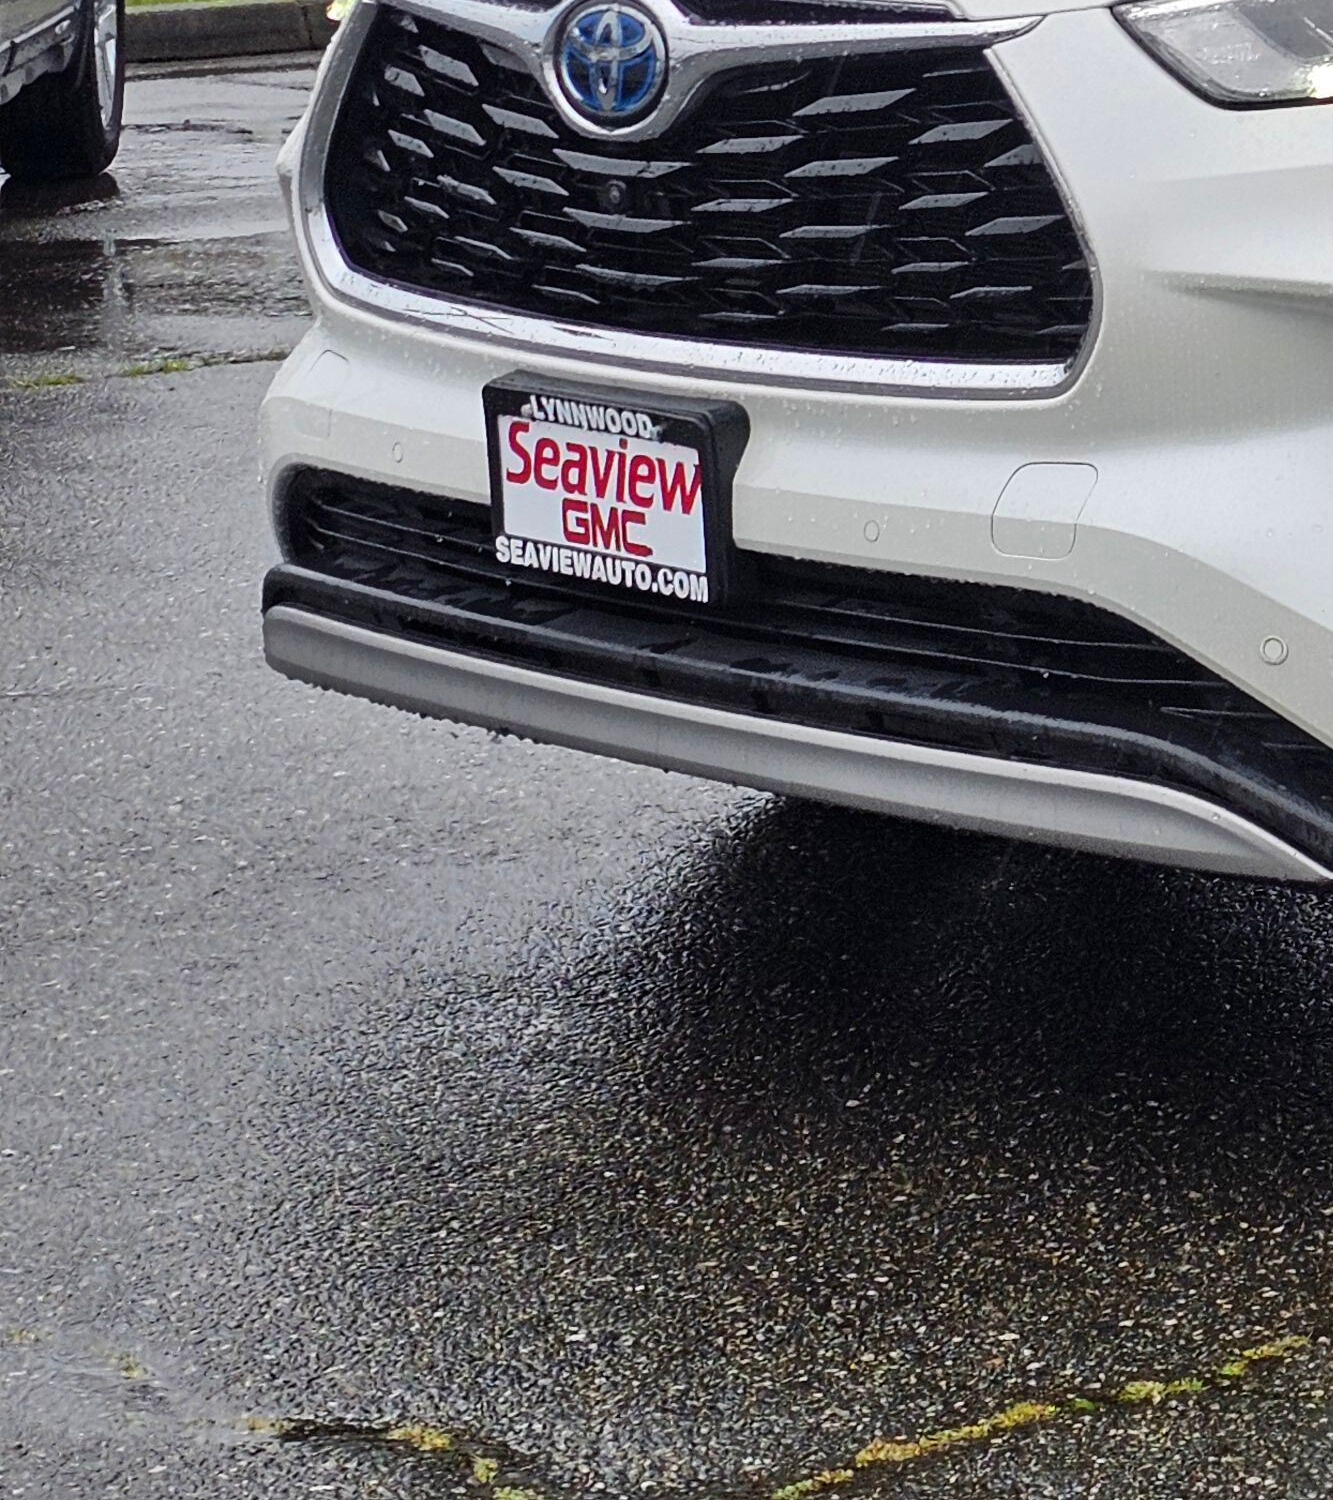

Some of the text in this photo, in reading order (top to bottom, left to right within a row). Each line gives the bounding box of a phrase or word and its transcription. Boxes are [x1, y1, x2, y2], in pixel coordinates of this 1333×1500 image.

[529, 394, 652, 439] LYNNWOOD
[506, 421, 701, 515] Seaview
[562, 498, 653, 556] GMC
[495, 535, 709, 603] SEAVIEWAUTO.COM
